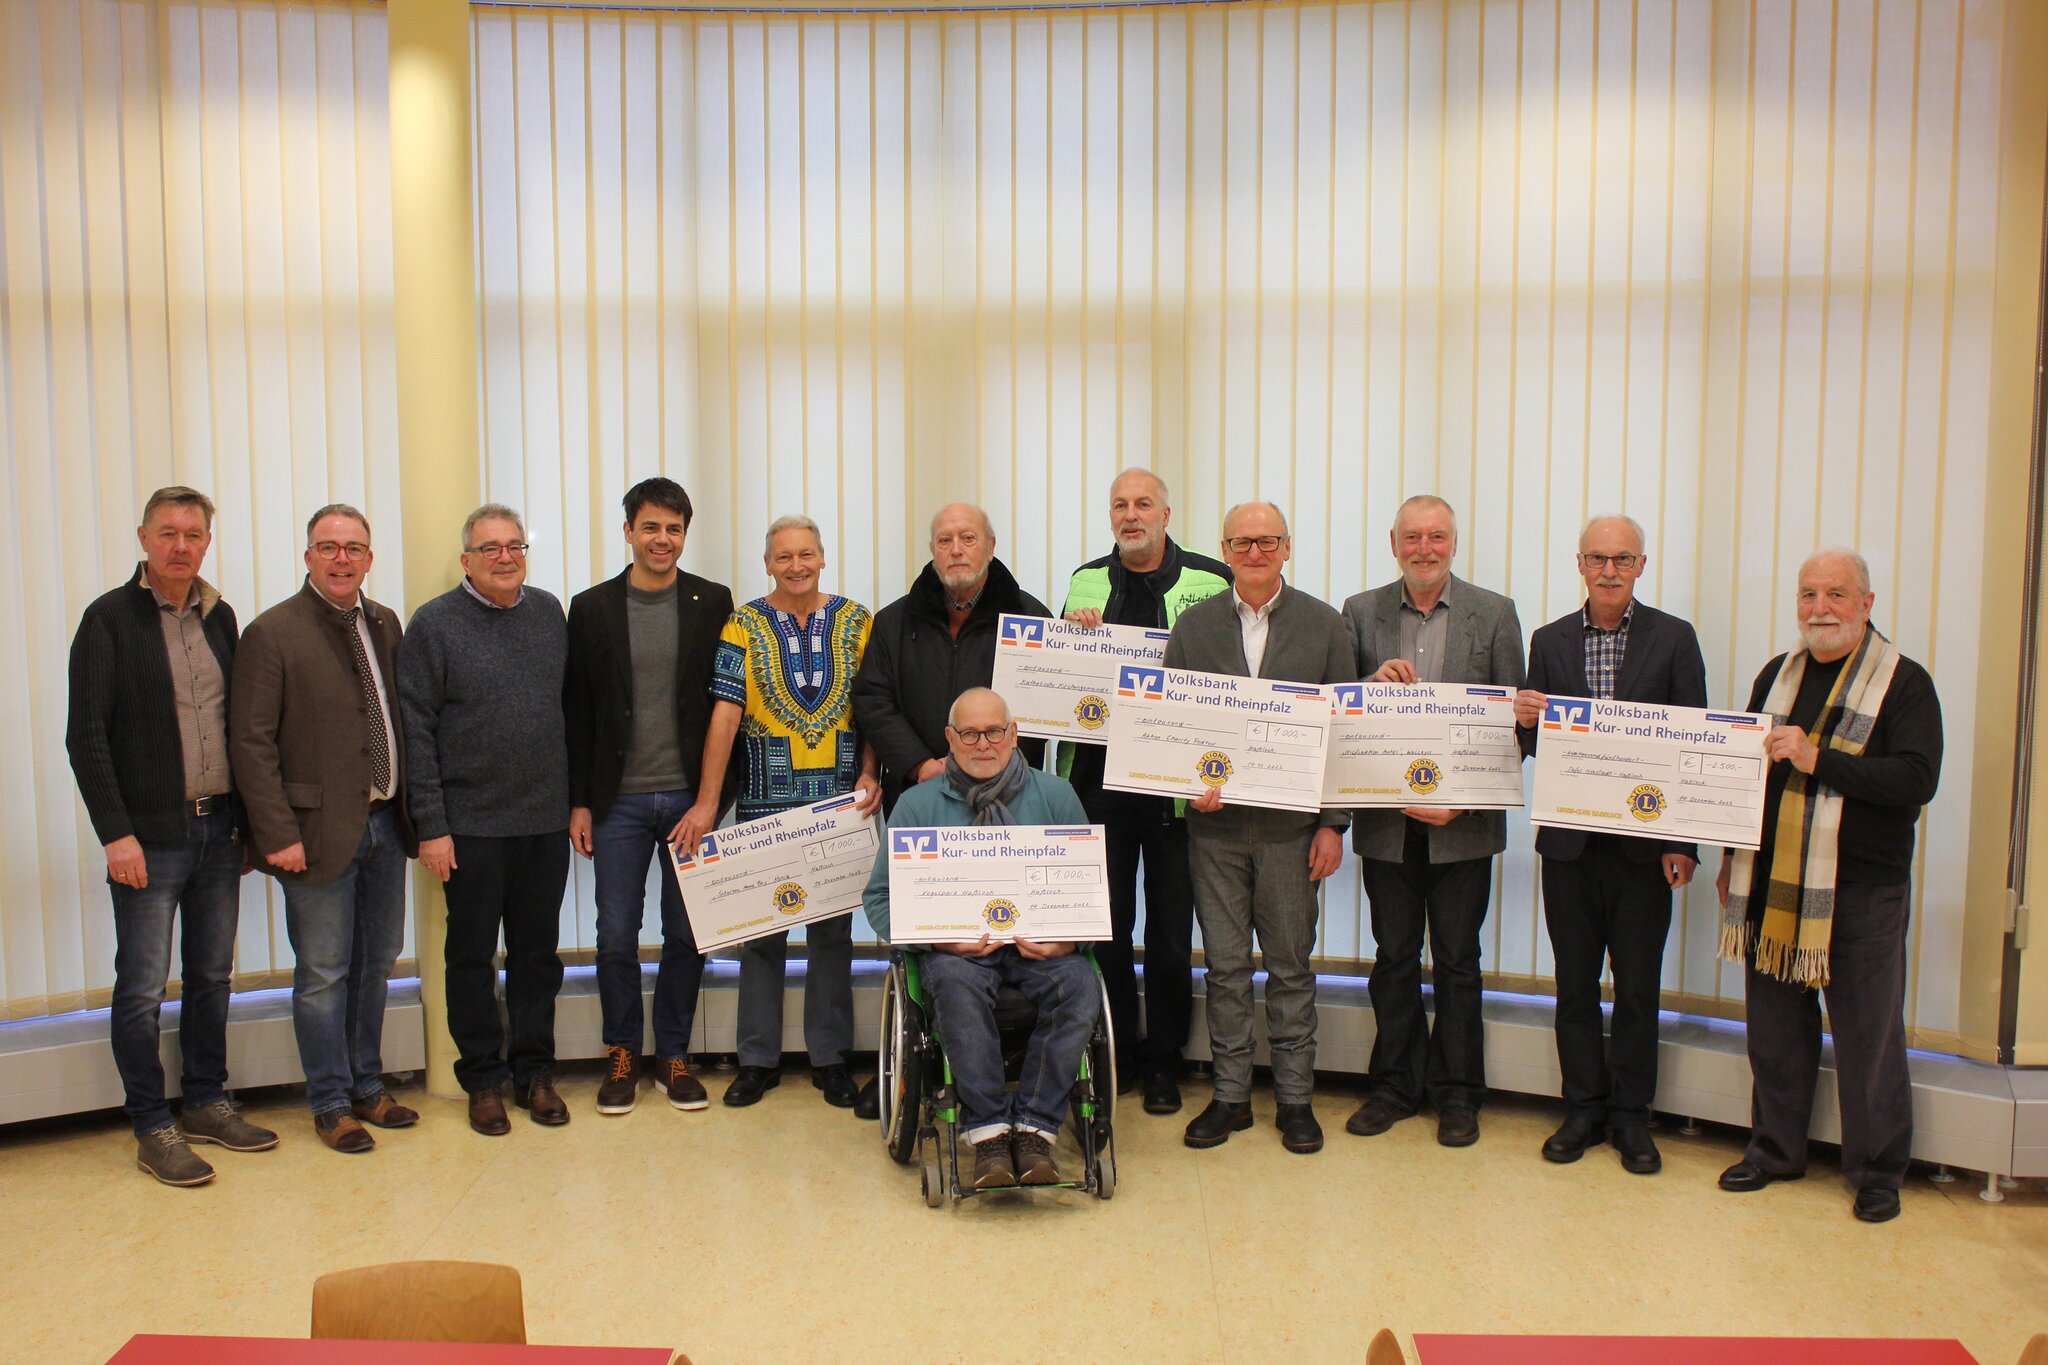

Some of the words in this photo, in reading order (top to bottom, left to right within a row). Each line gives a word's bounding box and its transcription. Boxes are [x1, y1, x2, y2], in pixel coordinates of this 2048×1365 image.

[1047, 622, 1113, 639] Volksbank
[1046, 638, 1070, 650] Kur-
[1074, 642, 1097, 653] und
[1101, 643, 1165, 660] Rheinpfalz
[1168, 672, 1238, 692] Volksbank
[1366, 686, 1436, 698] Volksbank
[1082, 696, 1105, 705] LIONS
[1166, 689, 1192, 702] Kur-
[1196, 693, 1221, 706] und
[1225, 696, 1292, 714] Rheinpfalz
[1088, 705, 1097, 719] L
[1366, 703, 1393, 714] Kur-
[1396, 703, 1422, 714] und
[1425, 703, 1487, 717] Rheinpfalz
[1595, 703, 1670, 722] Volksbank
[1166, 734, 1191, 745] Charity
[1593, 720, 1622, 734] Kur-
[1625, 723, 1651, 737] und
[1655, 725, 1728, 745] Rheinpfalz
[1205, 752, 1228, 762] LIONS
[1413, 760, 1435, 768] LIONS
[1684, 756, 1697, 768] €
[1210, 762, 1221, 776] L
[1420, 769, 1430, 783] L
[1636, 785, 1660, 796] LIONS
[1642, 795, 1653, 810] L
[717, 817, 784, 843] Volksbank
[941, 829, 1011, 842] Volksbank
[721, 844, 747, 858] Kur-
[749, 833, 774, 851] und
[776, 818, 837, 846] Rheinpfalz
[941, 847, 968, 858] Kur-
[971, 845, 997, 857] und
[1000, 844, 1066, 859] Rheinpfalz
[778, 884, 798, 895] LIONS
[785, 892, 796, 905] L
[989, 899, 1012, 909] LIONS
[996, 908, 1007, 921] L
